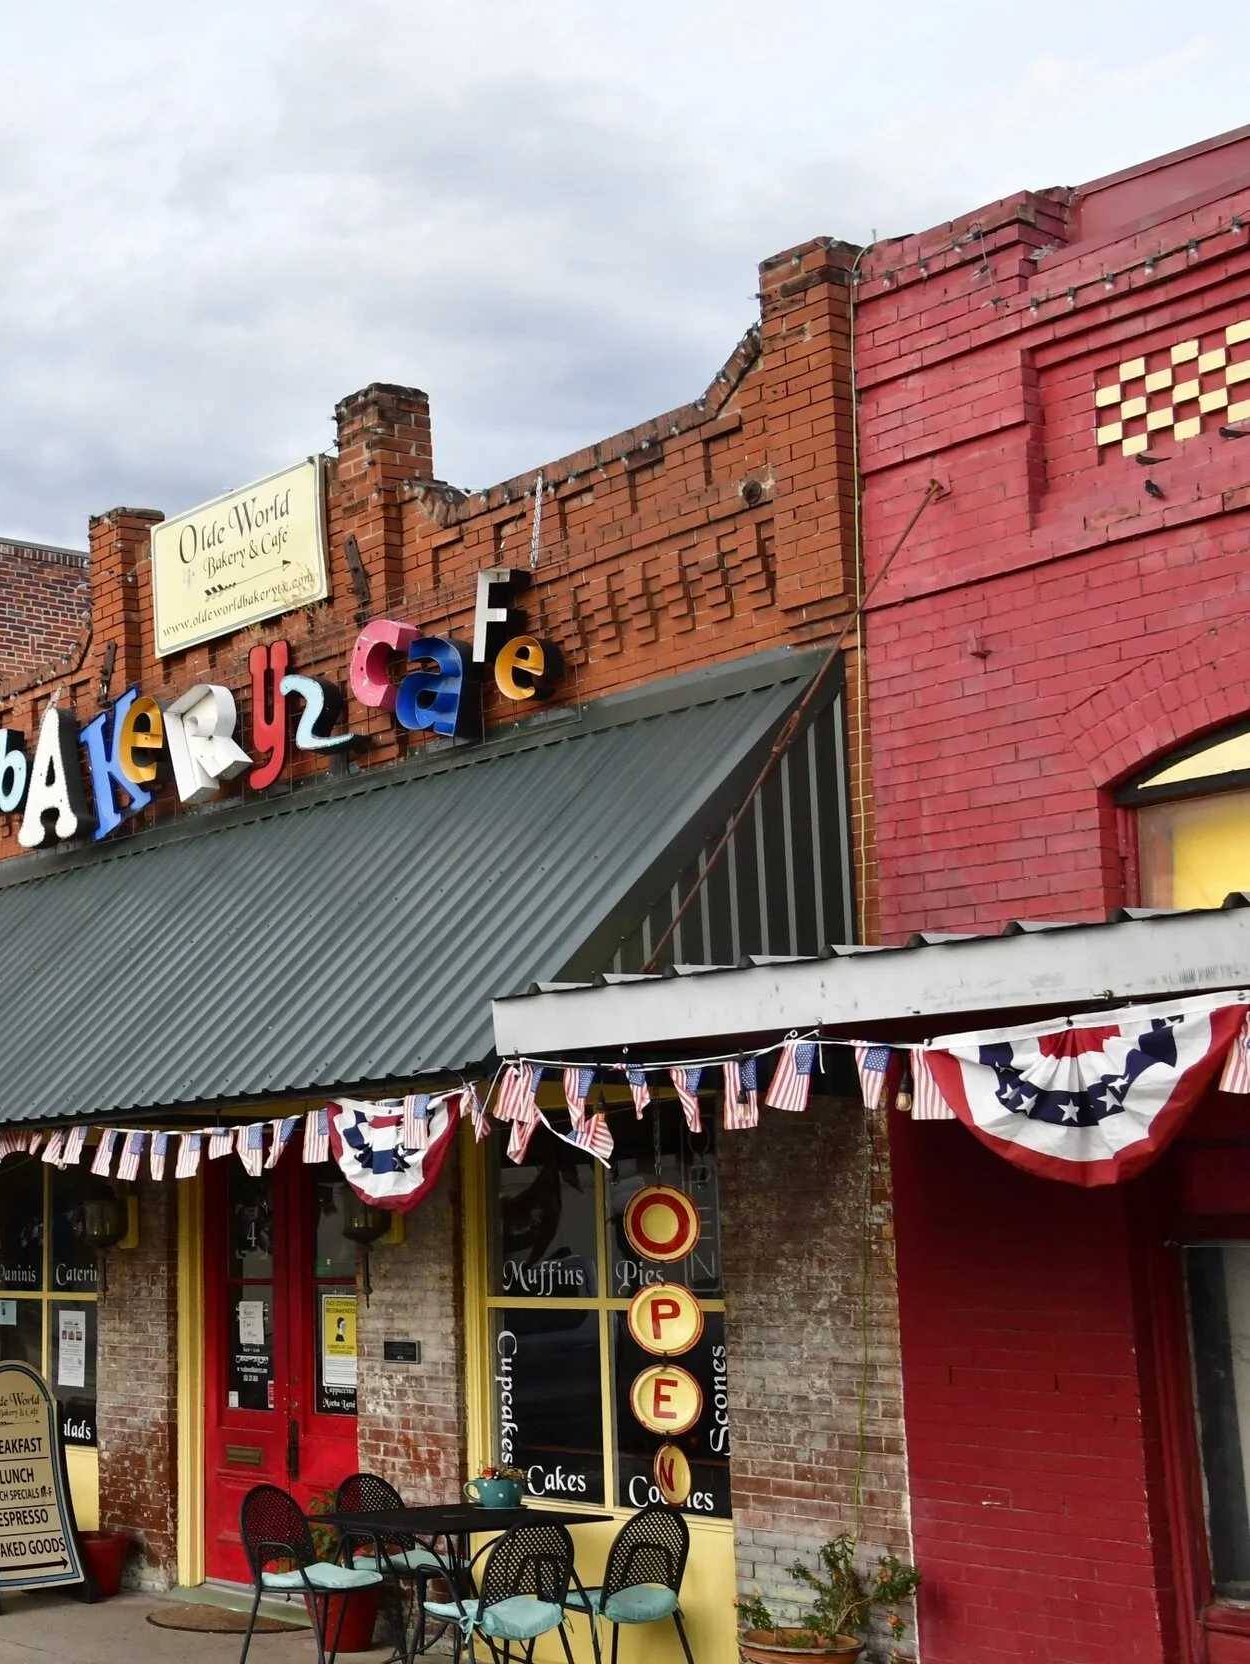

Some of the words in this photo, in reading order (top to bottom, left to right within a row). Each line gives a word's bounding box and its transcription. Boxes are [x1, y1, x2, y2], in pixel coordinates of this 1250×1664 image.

[179, 520, 226, 564] Olde
[228, 488, 291, 538] World
[203, 546, 246, 579] Bakery
[248, 540, 260, 560] &
[56, 1263, 97, 1286] Cateri
[503, 1260, 584, 1296] Muffins
[615, 1260, 665, 1295] Pies
[631, 1193, 691, 1493] OPEN
[9, 1392, 40, 1406] World
[495, 1330, 519, 1464] Cupcakes
[710, 1344, 729, 1456] Scones
[0, 1468, 34, 1484] LUNCH
[527, 1465, 587, 1495] Cakes
[629, 1476, 714, 1511] Coies
[10, 1487, 40, 1501] SPECIALS
[28, 1536, 66, 1556] GOODS
